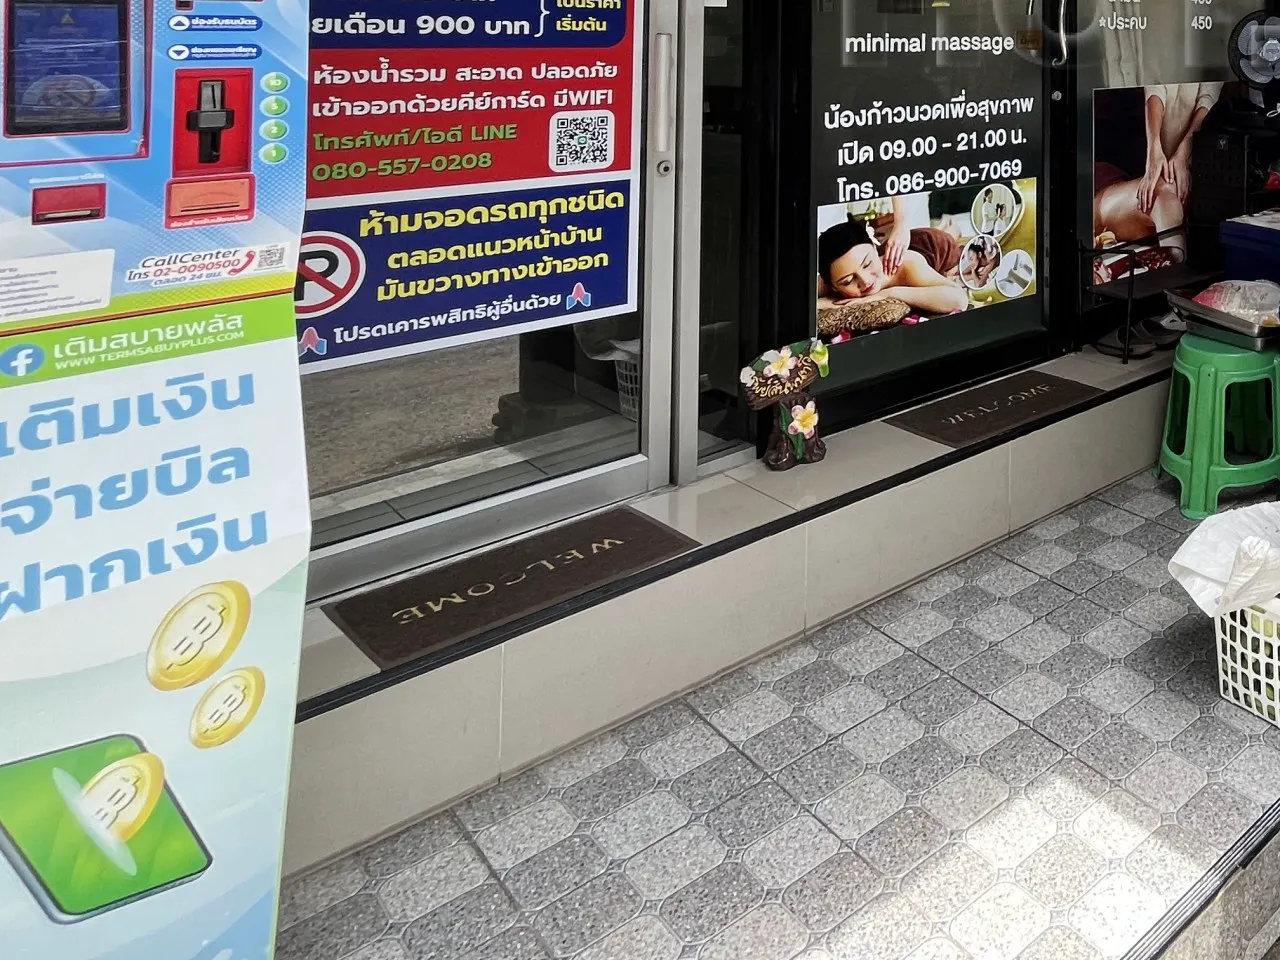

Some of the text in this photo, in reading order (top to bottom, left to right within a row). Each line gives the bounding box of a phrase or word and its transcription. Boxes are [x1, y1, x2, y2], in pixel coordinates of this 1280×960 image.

[311, 11, 530, 36] ยเดือน 900 บาท
[556, 17, 607, 33] เริ่มต้น
[1107, 12, 1212, 30] ประคบ 450
[845, 32, 926, 53] minimal
[931, 34, 1015, 56] massage
[313, 57, 618, 86] ห้องน้ำรวม สะอาด ปลอดภัย
[312, 89, 613, 118] เข้าออกด้วยคีย์การ์ด มีWIFI
[823, 89, 1034, 130] น้องก้าวนวดเพื่อสุขภาพ
[313, 123, 517, 152] โทรศัพท์/ไอดี LINE
[837, 140, 874, 166] เปิด
[879, 136, 937, 161] 09.00
[956, 129, 1007, 151] 21.00
[1011, 128, 1027, 145] น.
[312, 152, 493, 182] 080-557-0208
[837, 158, 1022, 203] โทร. 086-900-7069
[358, 189, 624, 238] ห้ามจอดรถทุกชนิด
[141, 249, 240, 269] CallCenter
[386, 225, 602, 269] ตลอดแนวหน้าบ้าน
[128, 258, 240, 281] โทร 02-0090500
[376, 250, 609, 302] มันขวางทางเข้าออก
[53, 313, 244, 358] เติมสบายพลัส
[333, 292, 562, 344] โปรดเคารพสิทธิผู้อื่นด้วย
[0, 372, 256, 459] เติมเงิน
[0, 445, 251, 536] จ่ายบิล
[391, 538, 624, 625] WELCOME
